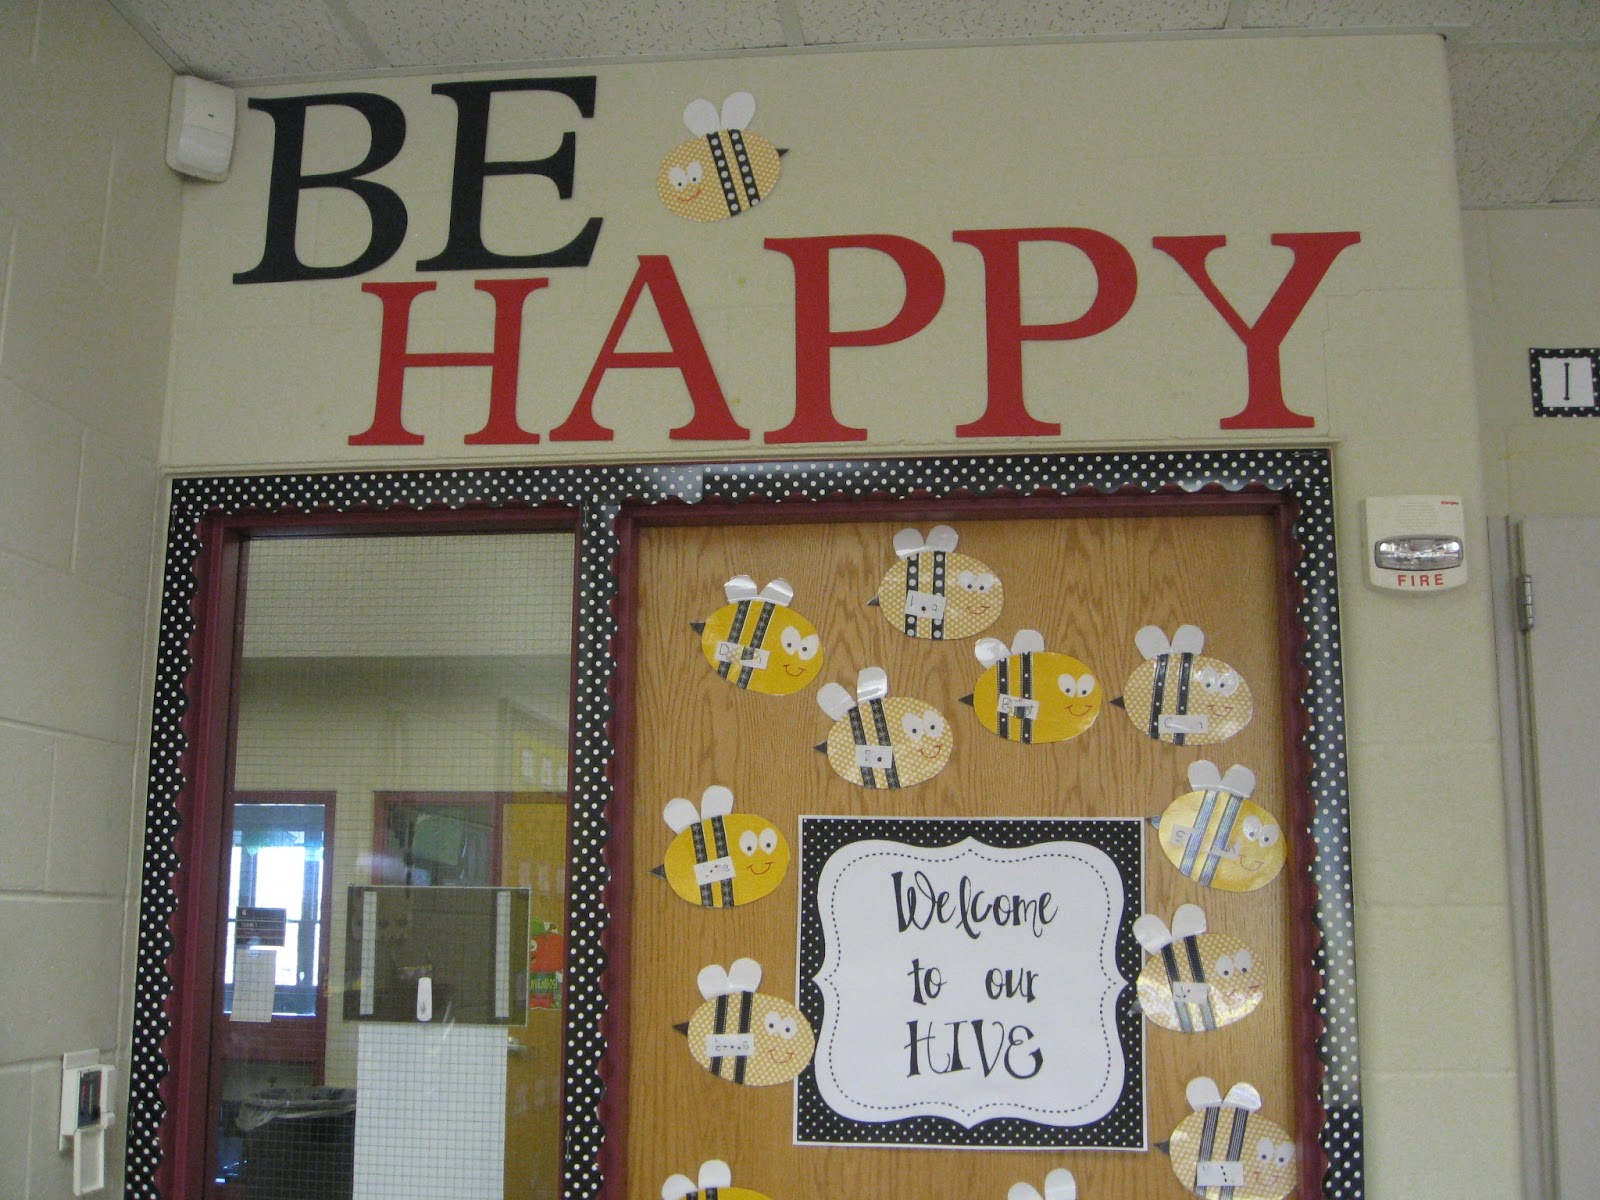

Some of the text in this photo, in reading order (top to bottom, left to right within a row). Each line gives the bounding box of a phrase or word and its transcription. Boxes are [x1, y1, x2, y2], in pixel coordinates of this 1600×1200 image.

[233, 76, 603, 284] BE
[350, 228, 1360, 445] HAPPY
[1397, 573, 1444, 587] FIRE
[891, 870, 1058, 940] Welcome
[907, 958, 1039, 1006] to our
[904, 1018, 1044, 1080] HIVE
